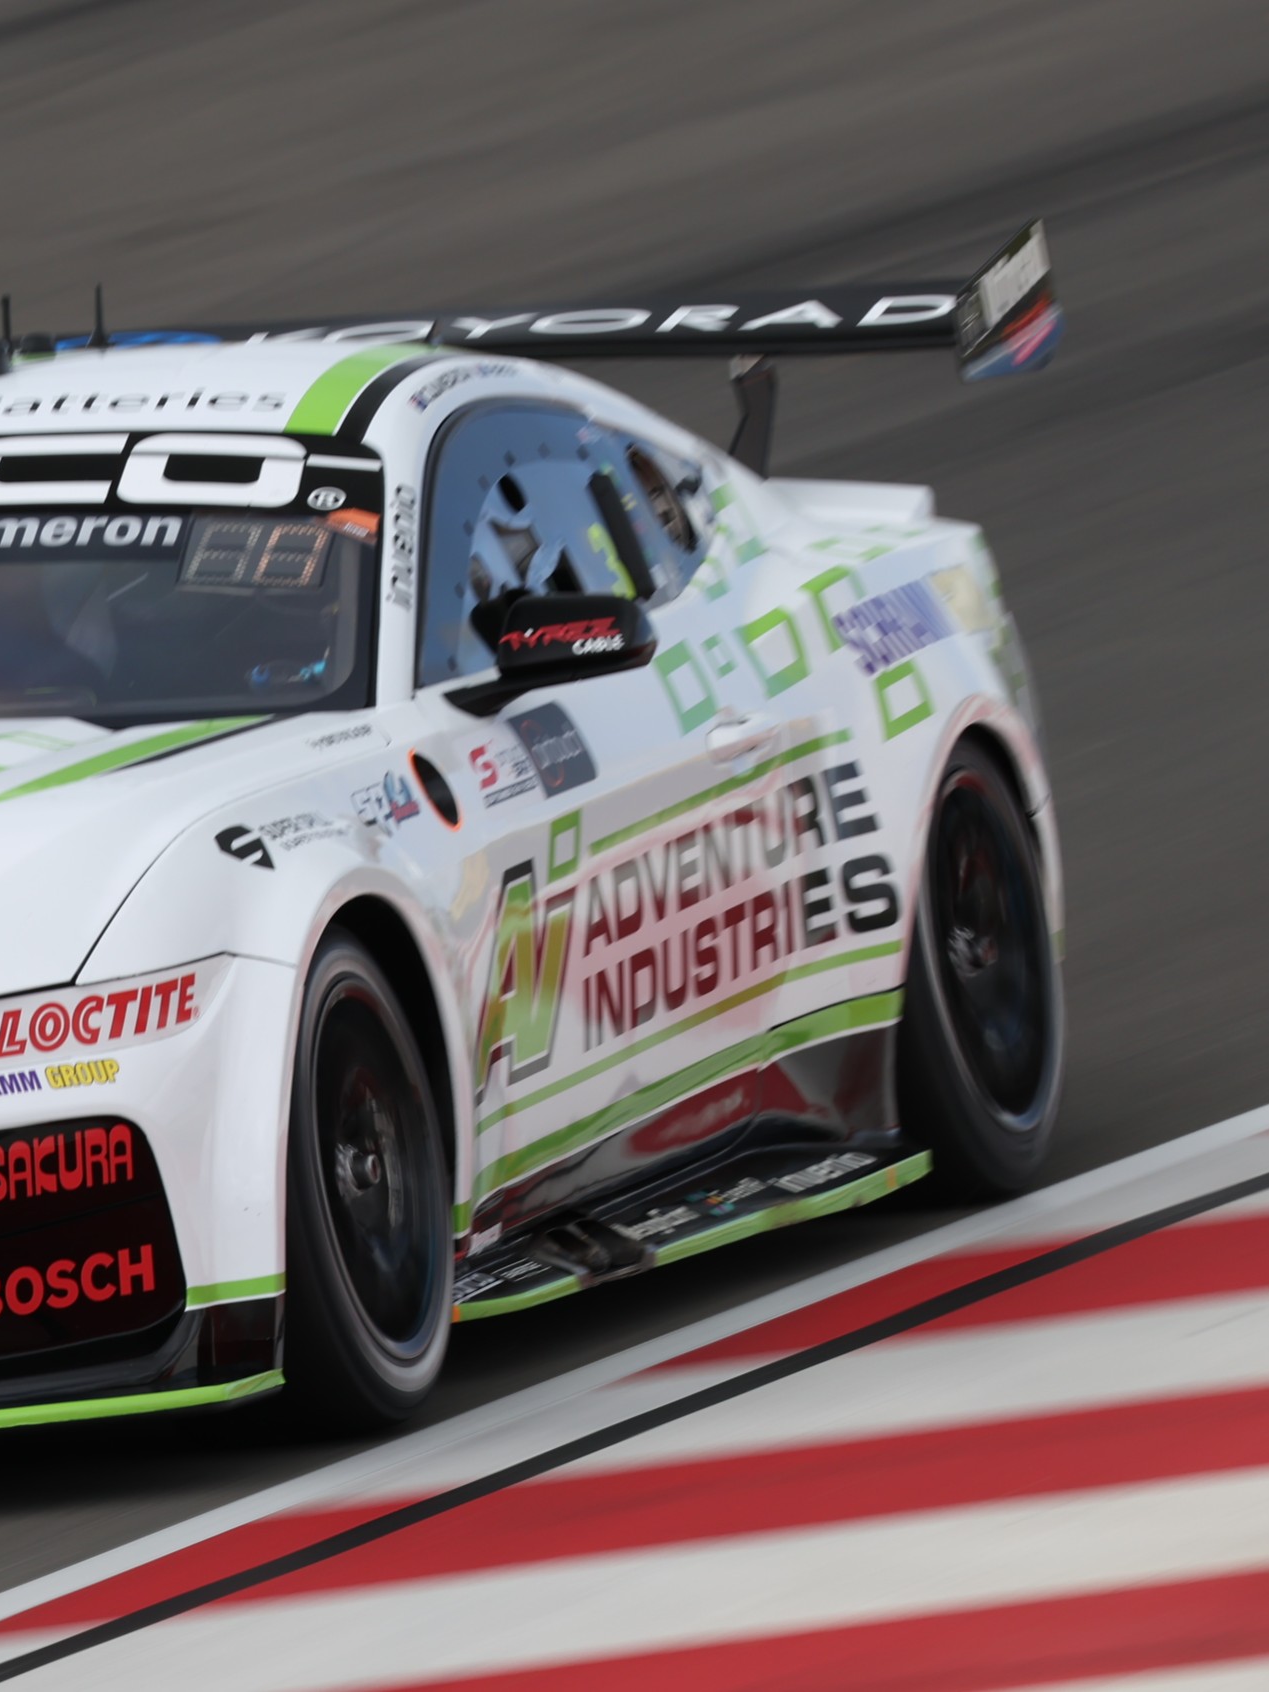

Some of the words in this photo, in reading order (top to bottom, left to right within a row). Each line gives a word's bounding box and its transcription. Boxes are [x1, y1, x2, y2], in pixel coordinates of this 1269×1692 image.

[581, 760, 879, 958] ADVENTURE
[581, 852, 900, 1052] INDUSTRIES
[45, 1059, 120, 1090] GROUP
